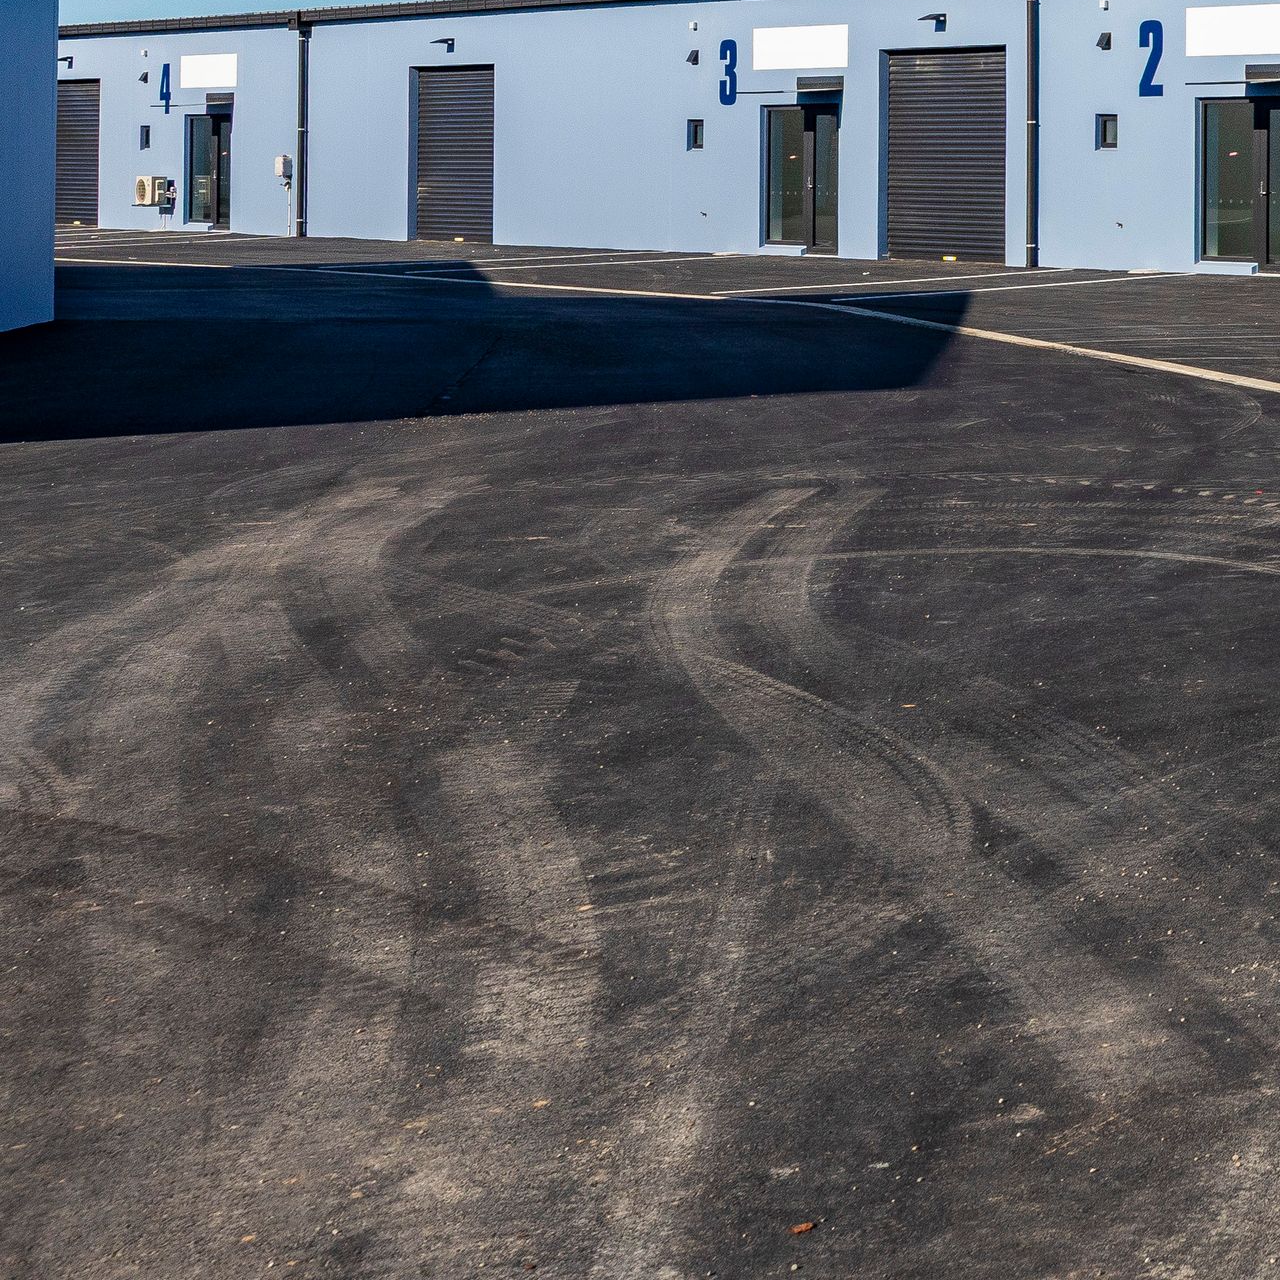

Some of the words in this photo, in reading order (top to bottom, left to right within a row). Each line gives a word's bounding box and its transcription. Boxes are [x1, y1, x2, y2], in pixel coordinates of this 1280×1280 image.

[159, 63, 171, 115] 4
[719, 38, 737, 106] 3
[1138, 19, 1164, 97] 2
